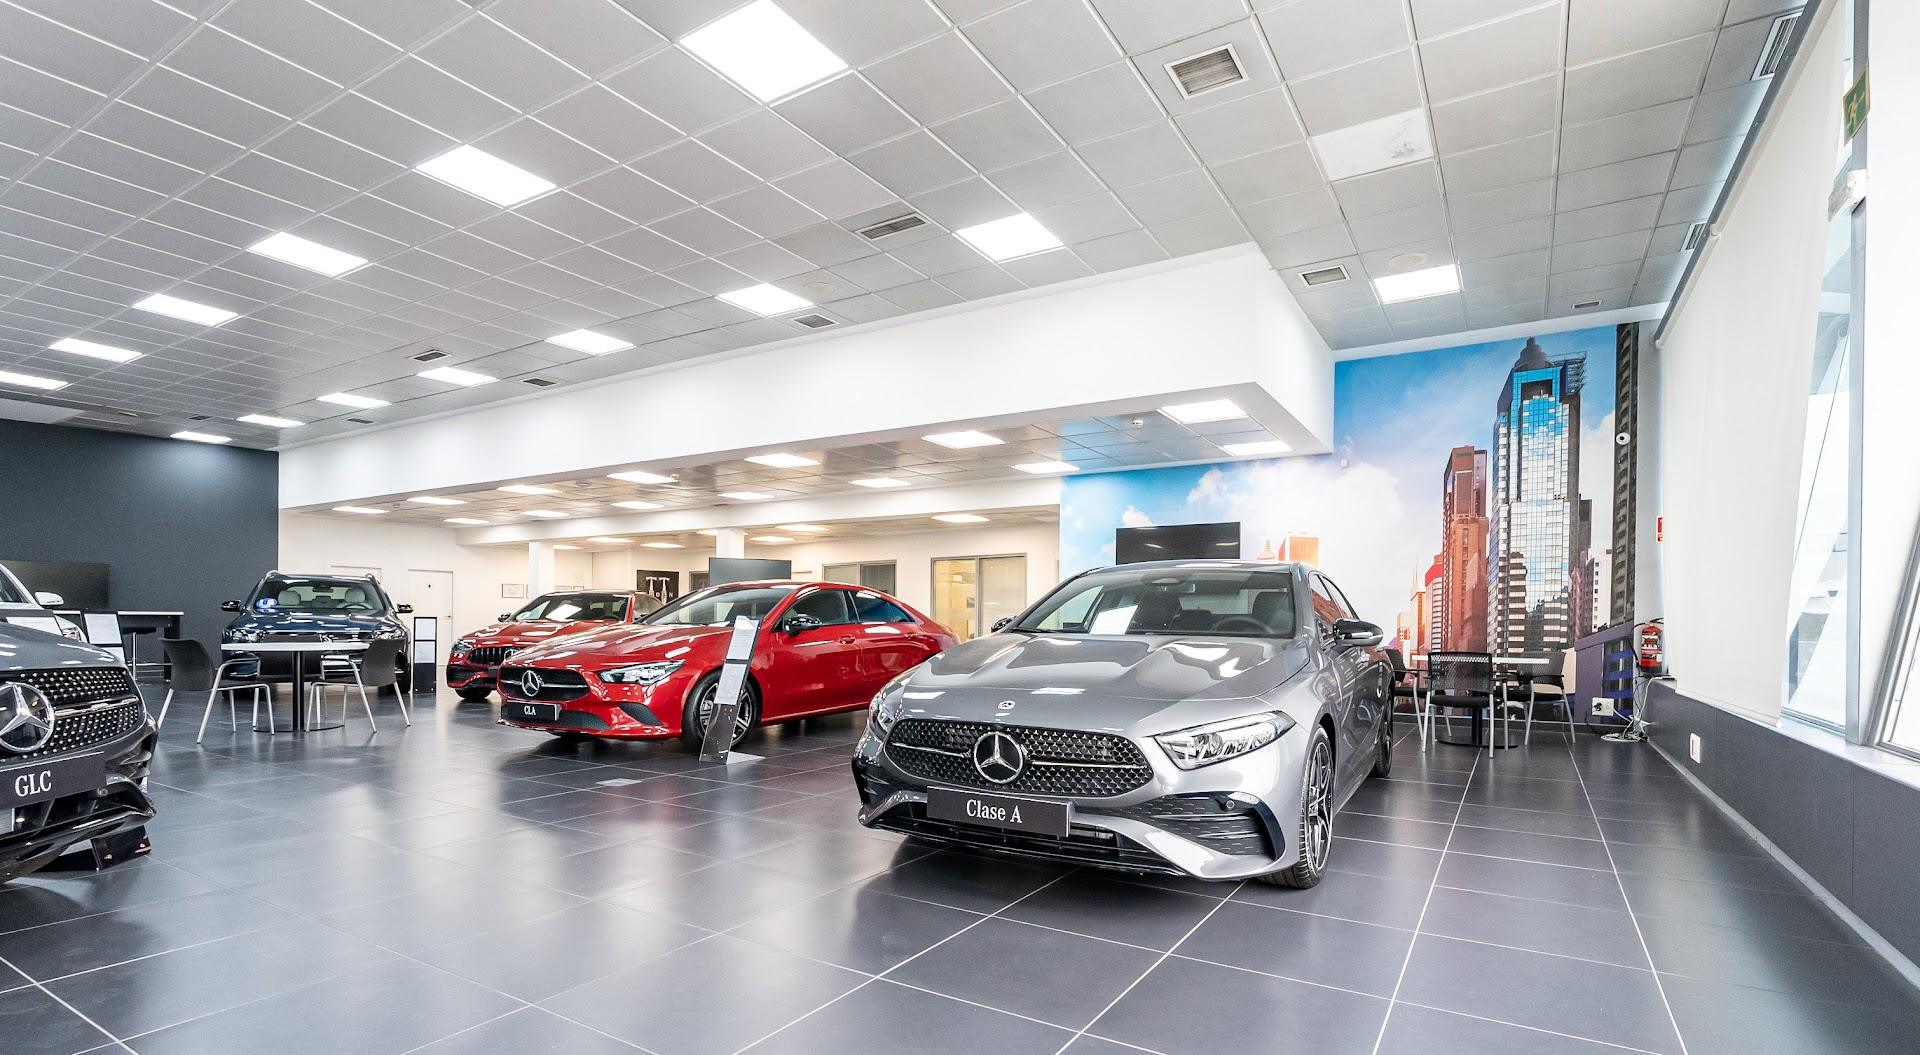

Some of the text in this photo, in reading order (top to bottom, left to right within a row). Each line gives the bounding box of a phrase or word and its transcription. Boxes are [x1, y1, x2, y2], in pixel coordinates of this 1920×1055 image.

[524, 705, 536, 715] CLA
[15, 770, 52, 797] GLC
[966, 799, 1023, 824] Clase A
